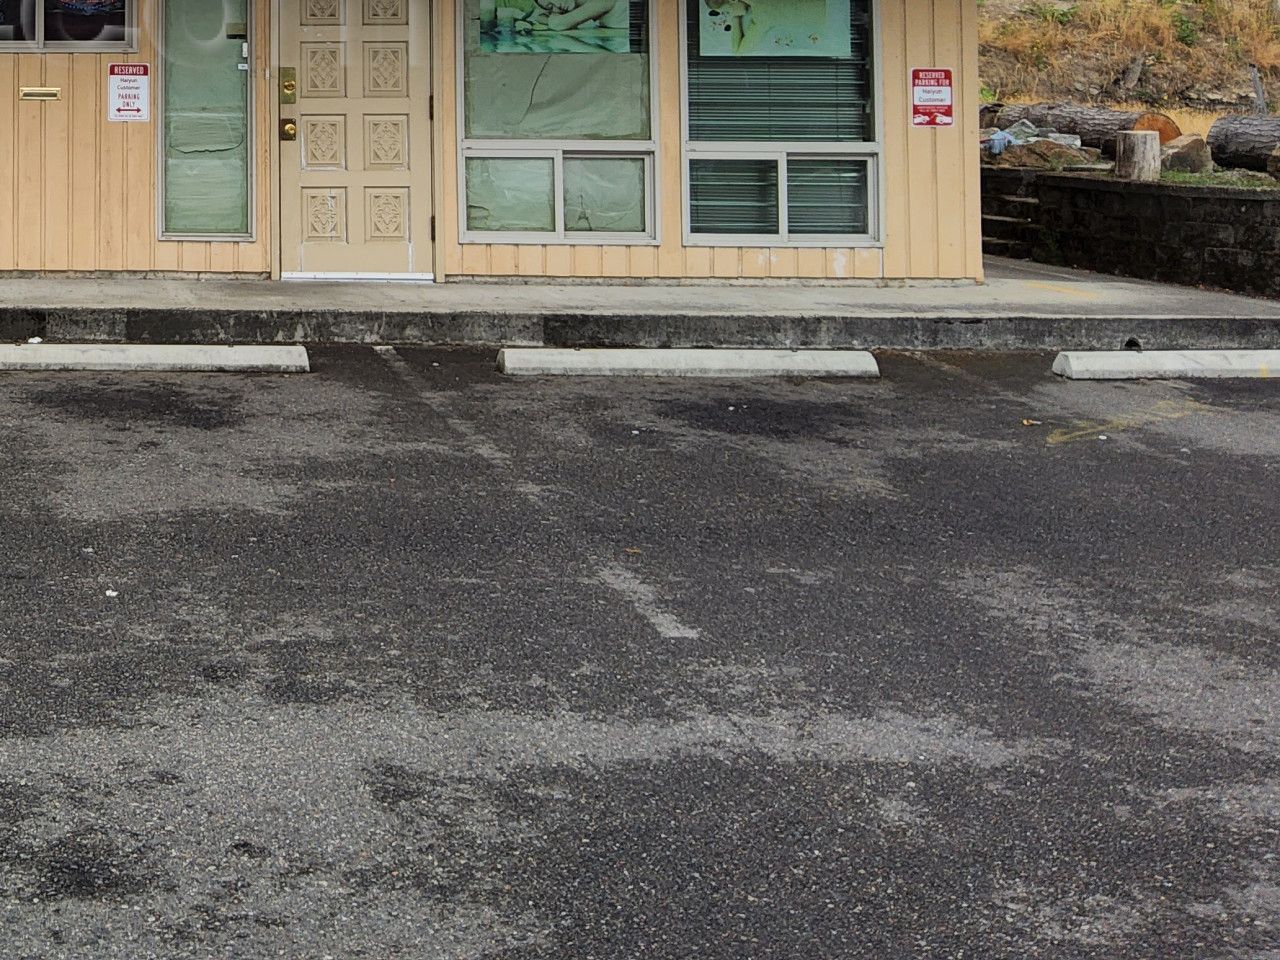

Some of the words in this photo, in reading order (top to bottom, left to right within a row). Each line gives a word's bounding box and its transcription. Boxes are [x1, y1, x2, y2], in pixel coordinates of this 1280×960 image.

[114, 66, 144, 75] RESERVED
[919, 71, 945, 79] RESERVED
[117, 93, 141, 101] PARKING
